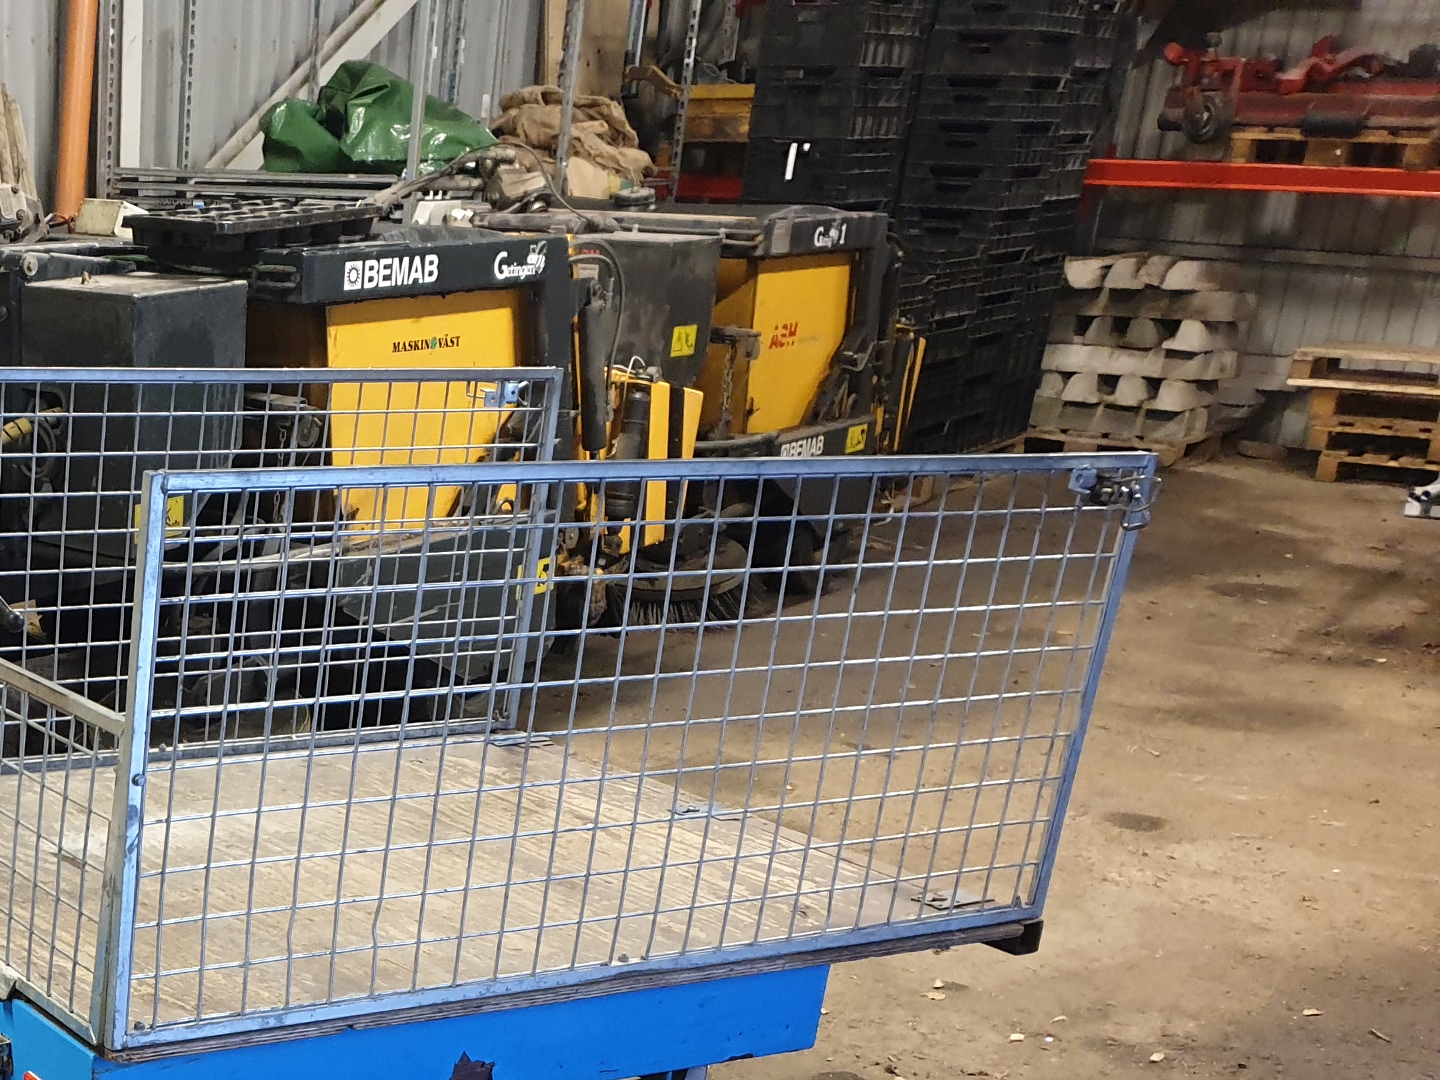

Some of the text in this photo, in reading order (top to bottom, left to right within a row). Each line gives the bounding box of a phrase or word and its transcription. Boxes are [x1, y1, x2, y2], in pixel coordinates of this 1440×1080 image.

[363, 254, 439, 288] BEMAB
[391, 337, 431, 353] MASKIN
[789, 435, 825, 457] BEMAB
